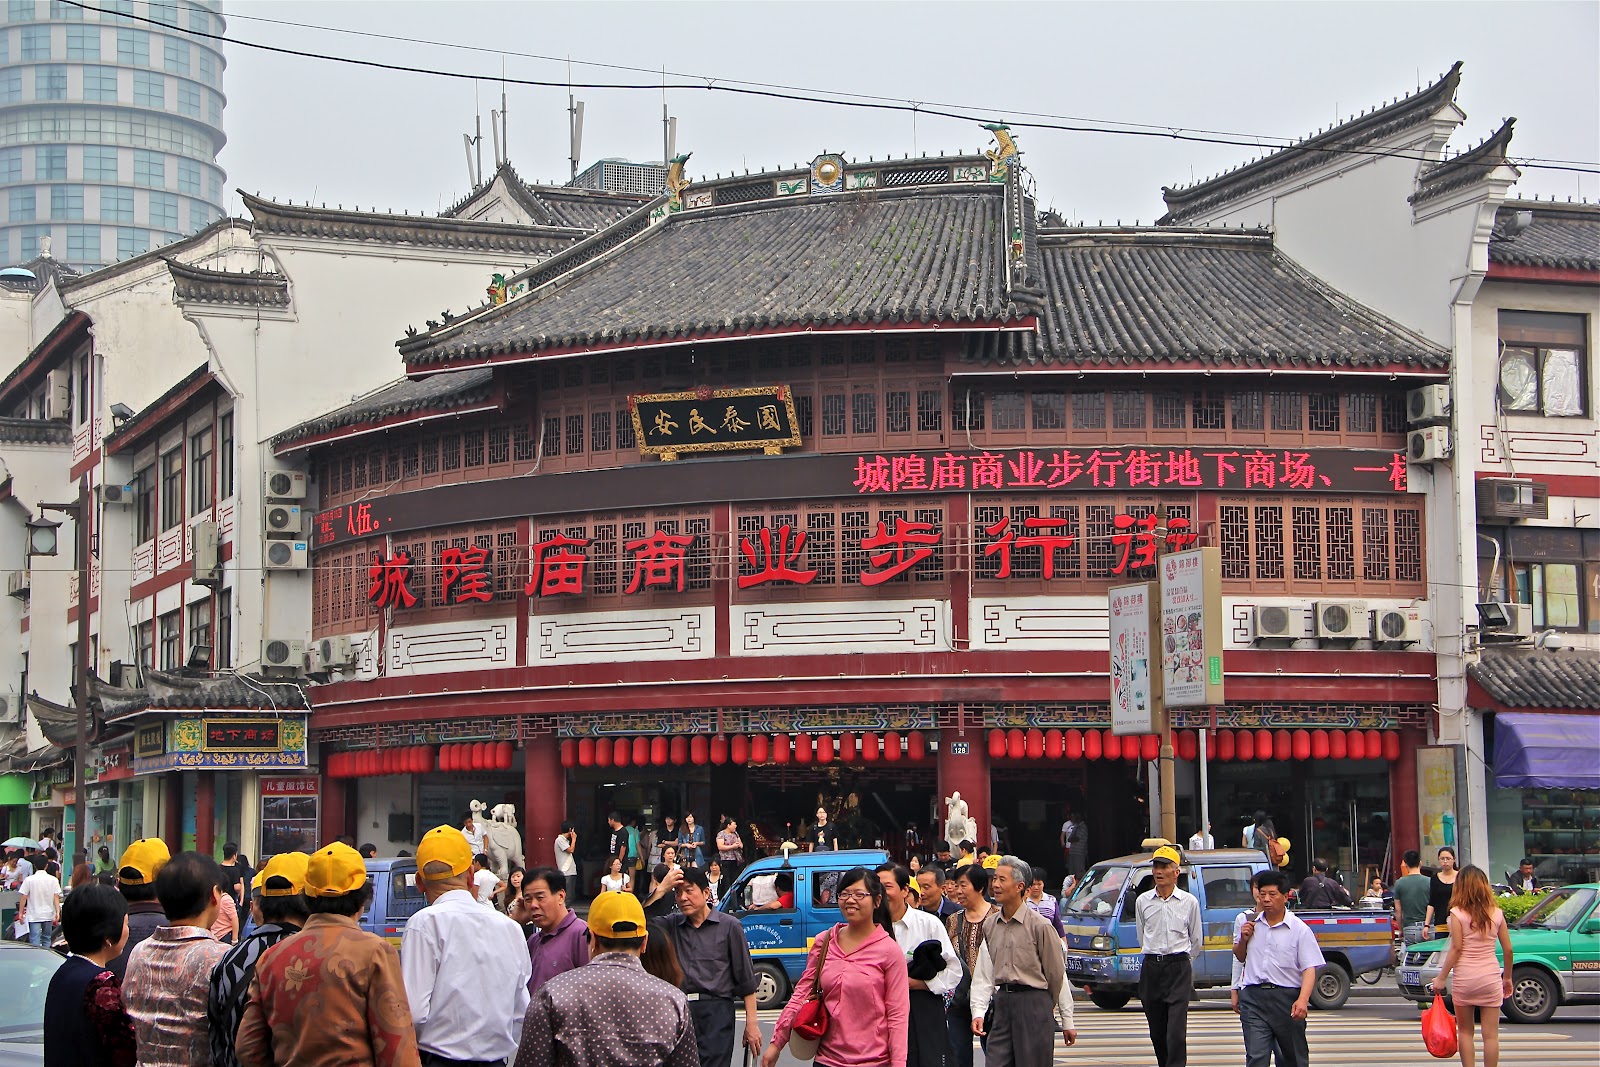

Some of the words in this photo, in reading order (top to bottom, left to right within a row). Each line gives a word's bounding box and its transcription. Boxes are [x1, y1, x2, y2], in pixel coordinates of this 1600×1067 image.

[368, 512, 1199, 609] 城隍庙商业步行街
[210, 729, 275, 742] 地下商场
[266, 781, 315, 792] 儿童服饰区
[1572, 962, 1600, 970] NINGB
